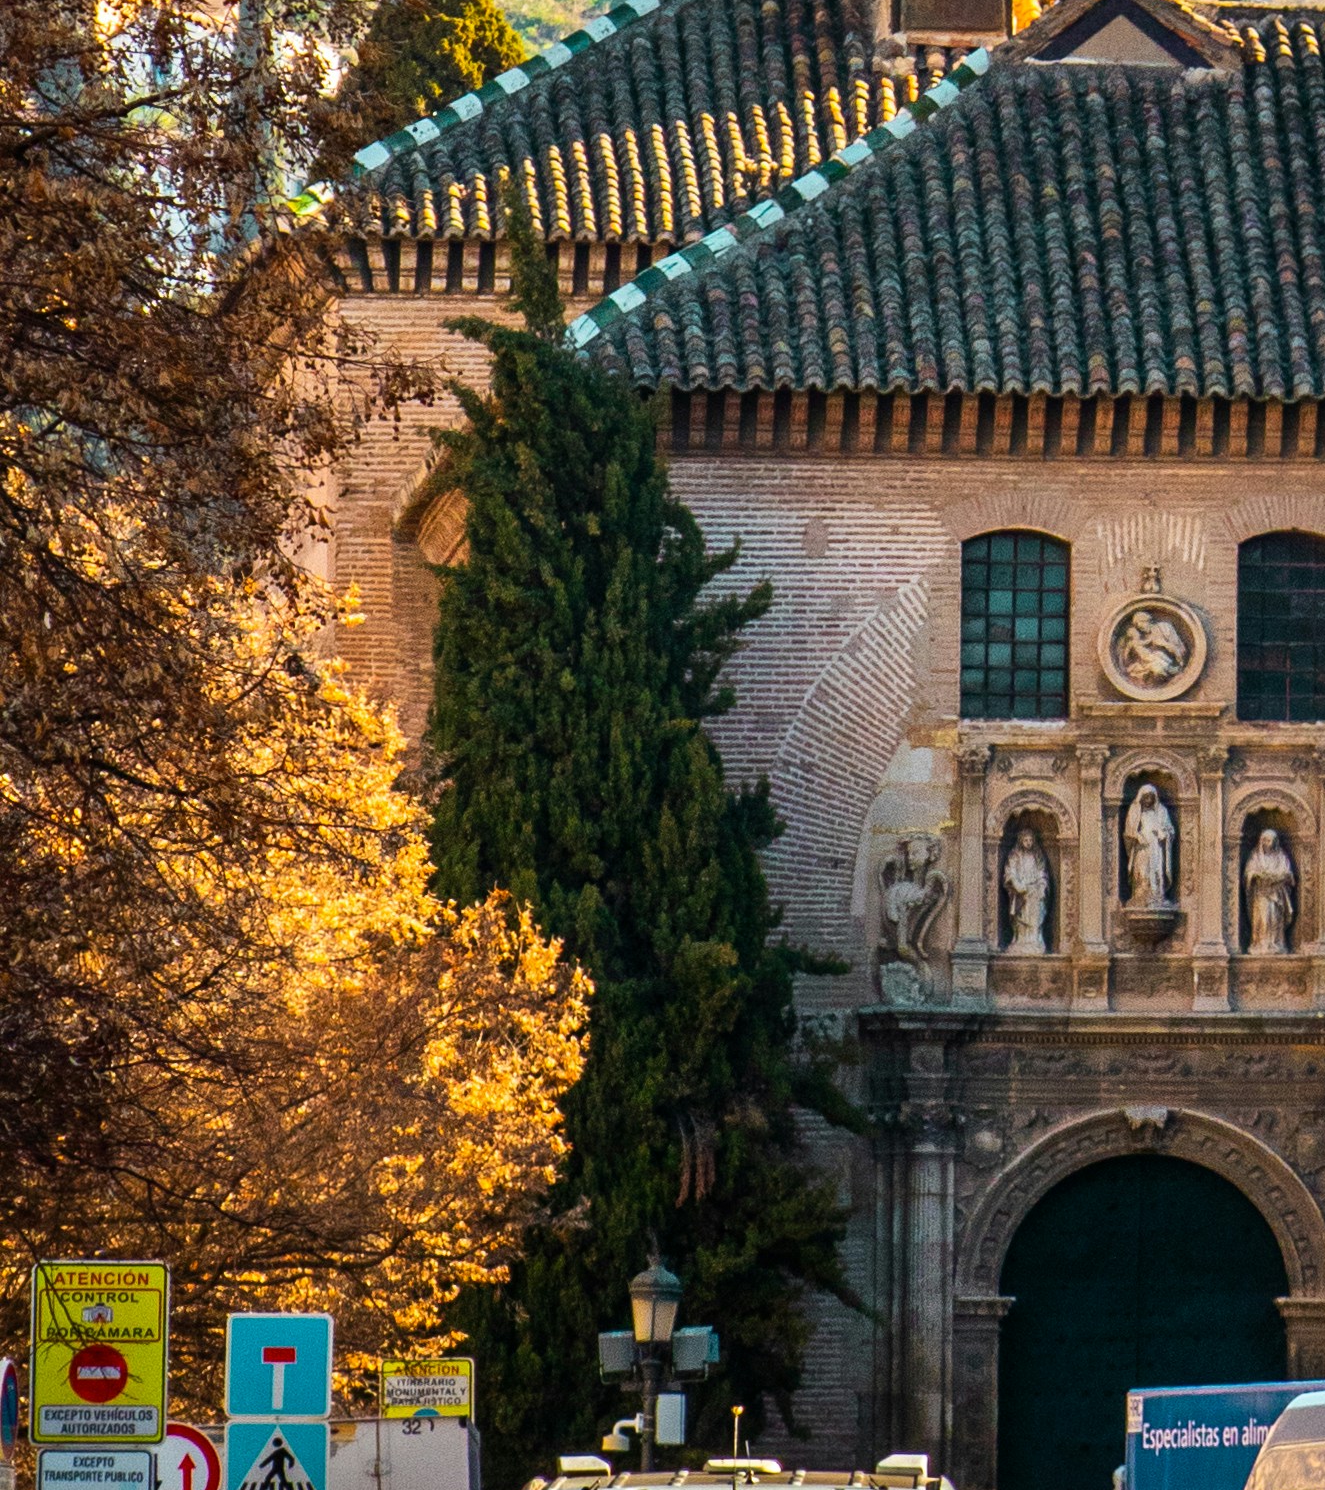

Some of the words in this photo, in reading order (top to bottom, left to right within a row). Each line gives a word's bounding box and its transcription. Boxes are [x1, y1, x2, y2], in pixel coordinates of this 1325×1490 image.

[54, 1270, 149, 1286] ATENCIÓN
[60, 1292, 139, 1303] CONTROL
[46, 1327, 78, 1338] POR
[460, 1388, 467, 1396] Y
[44, 1410, 91, 1421] EXCEPTO
[60, 1423, 136, 1435] AUTORIZADOS
[1142, 1420, 1220, 1456] Especialistas
[1222, 1426, 1239, 1447] en
[72, 1457, 115, 1468] EXCEPTO
[44, 1471, 103, 1482] TRANSPORTE
